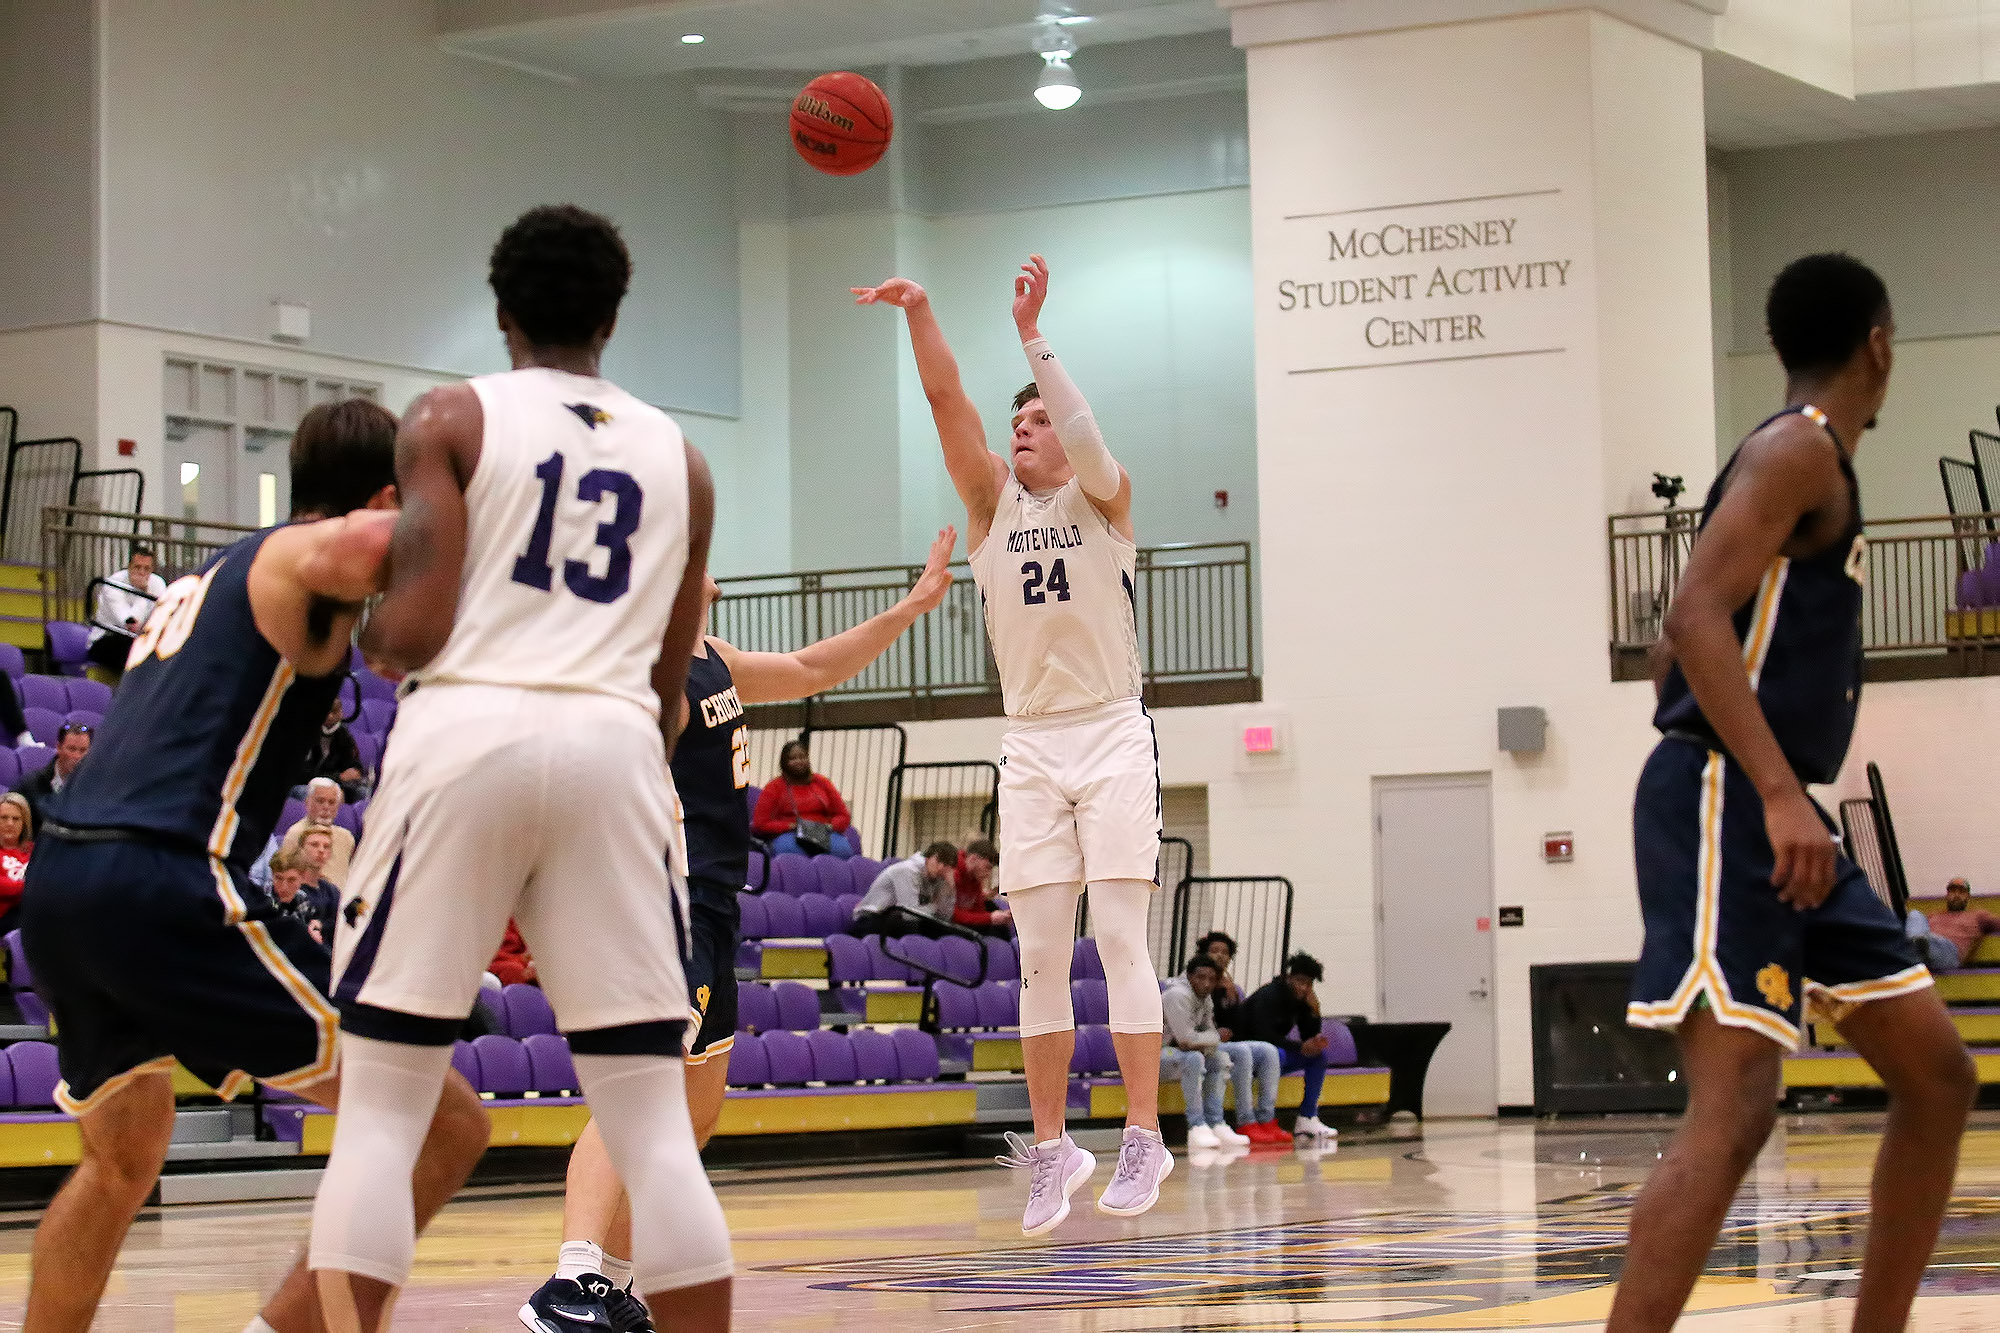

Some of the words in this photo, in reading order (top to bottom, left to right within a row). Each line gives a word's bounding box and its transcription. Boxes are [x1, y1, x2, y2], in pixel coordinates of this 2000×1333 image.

[798, 95, 854, 131] Wilson
[1279, 273, 1418, 311] STUDENT
[1426, 260, 1572, 298] ACTIVITY
[1365, 315, 1485, 348] CENTER
[511, 450, 643, 604] 13
[1021, 558, 1071, 605] 24
